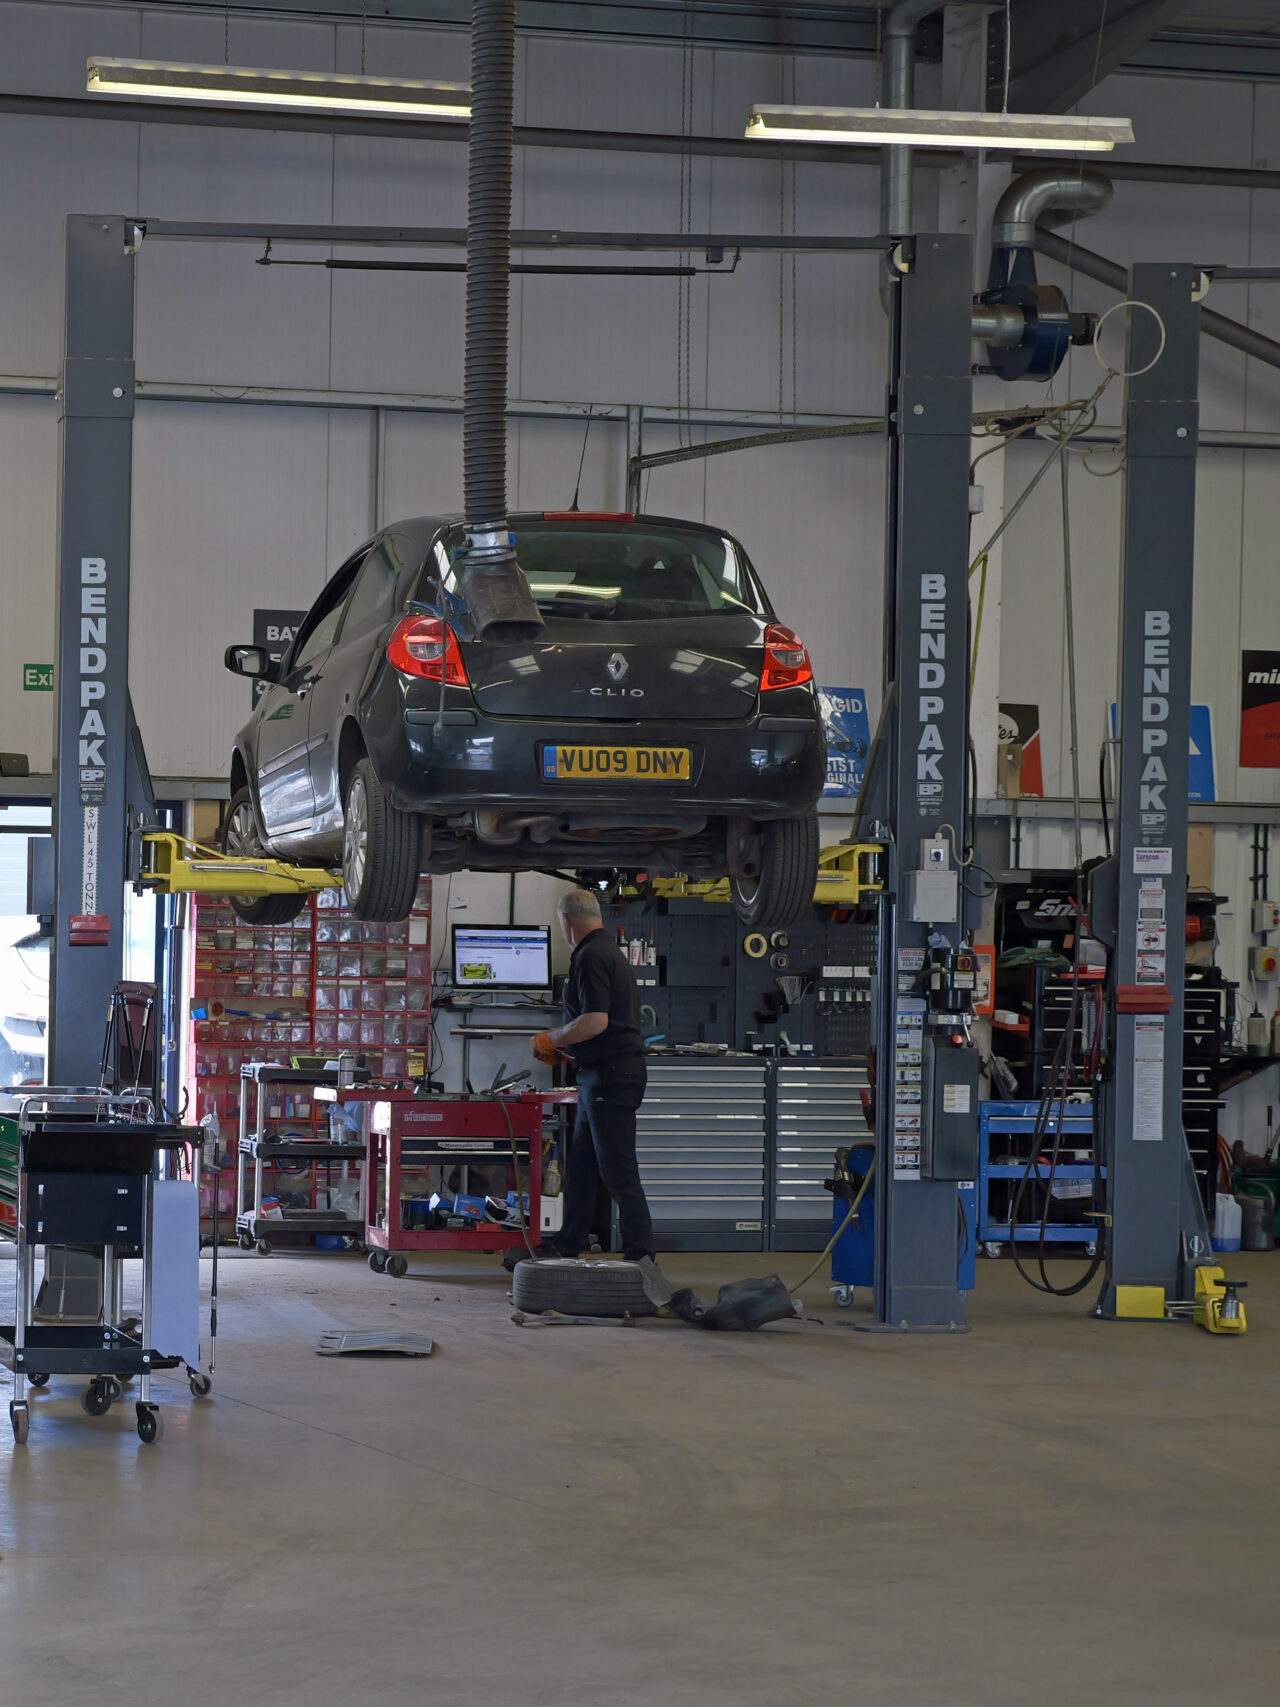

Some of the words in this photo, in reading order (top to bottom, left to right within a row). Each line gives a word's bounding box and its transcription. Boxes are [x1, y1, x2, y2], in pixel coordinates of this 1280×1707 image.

[267, 626, 300, 641] BAT
[78, 557, 106, 766] BENDPAK
[26, 670, 54, 686] Exi
[916, 574, 946, 780] BENDPAK
[590, 688, 644, 697] CLIO
[1140, 610, 1170, 810] BENDPAK
[562, 750, 628, 772] VU09
[636, 751, 684, 774] DNY
[80, 770, 104, 782] BP
[919, 784, 942, 796] BP
